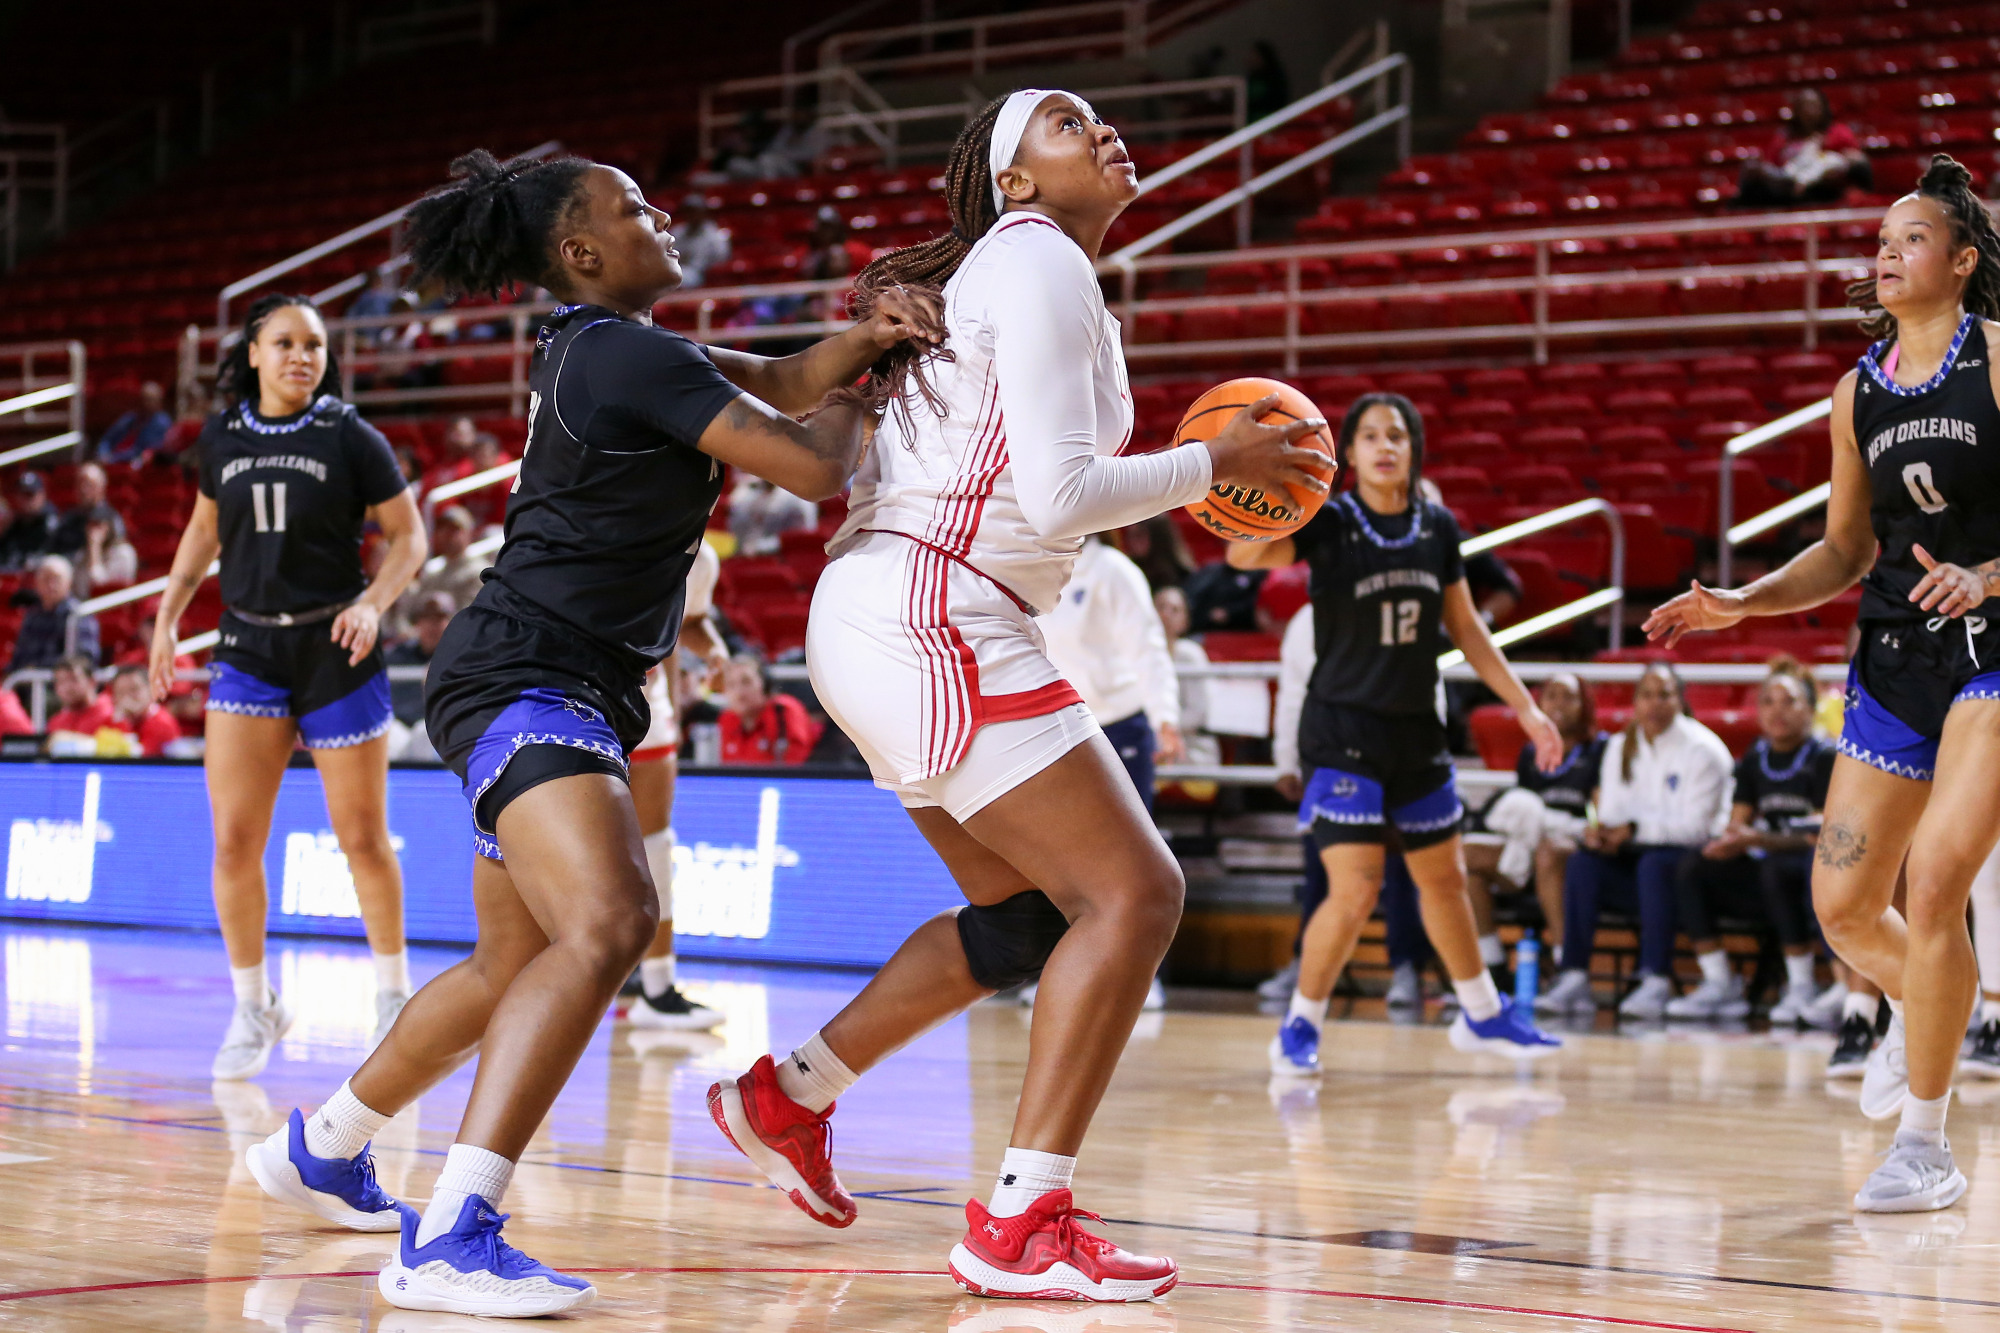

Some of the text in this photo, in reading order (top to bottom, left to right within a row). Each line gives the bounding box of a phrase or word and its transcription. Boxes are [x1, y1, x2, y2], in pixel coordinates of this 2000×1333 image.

[1867, 417, 1977, 468] NEW ORLEANS
[221, 455, 327, 485] NEW ORLEANS
[1901, 461, 1949, 515] 0
[251, 482, 287, 532] 11
[1380, 599, 1421, 646] 12
